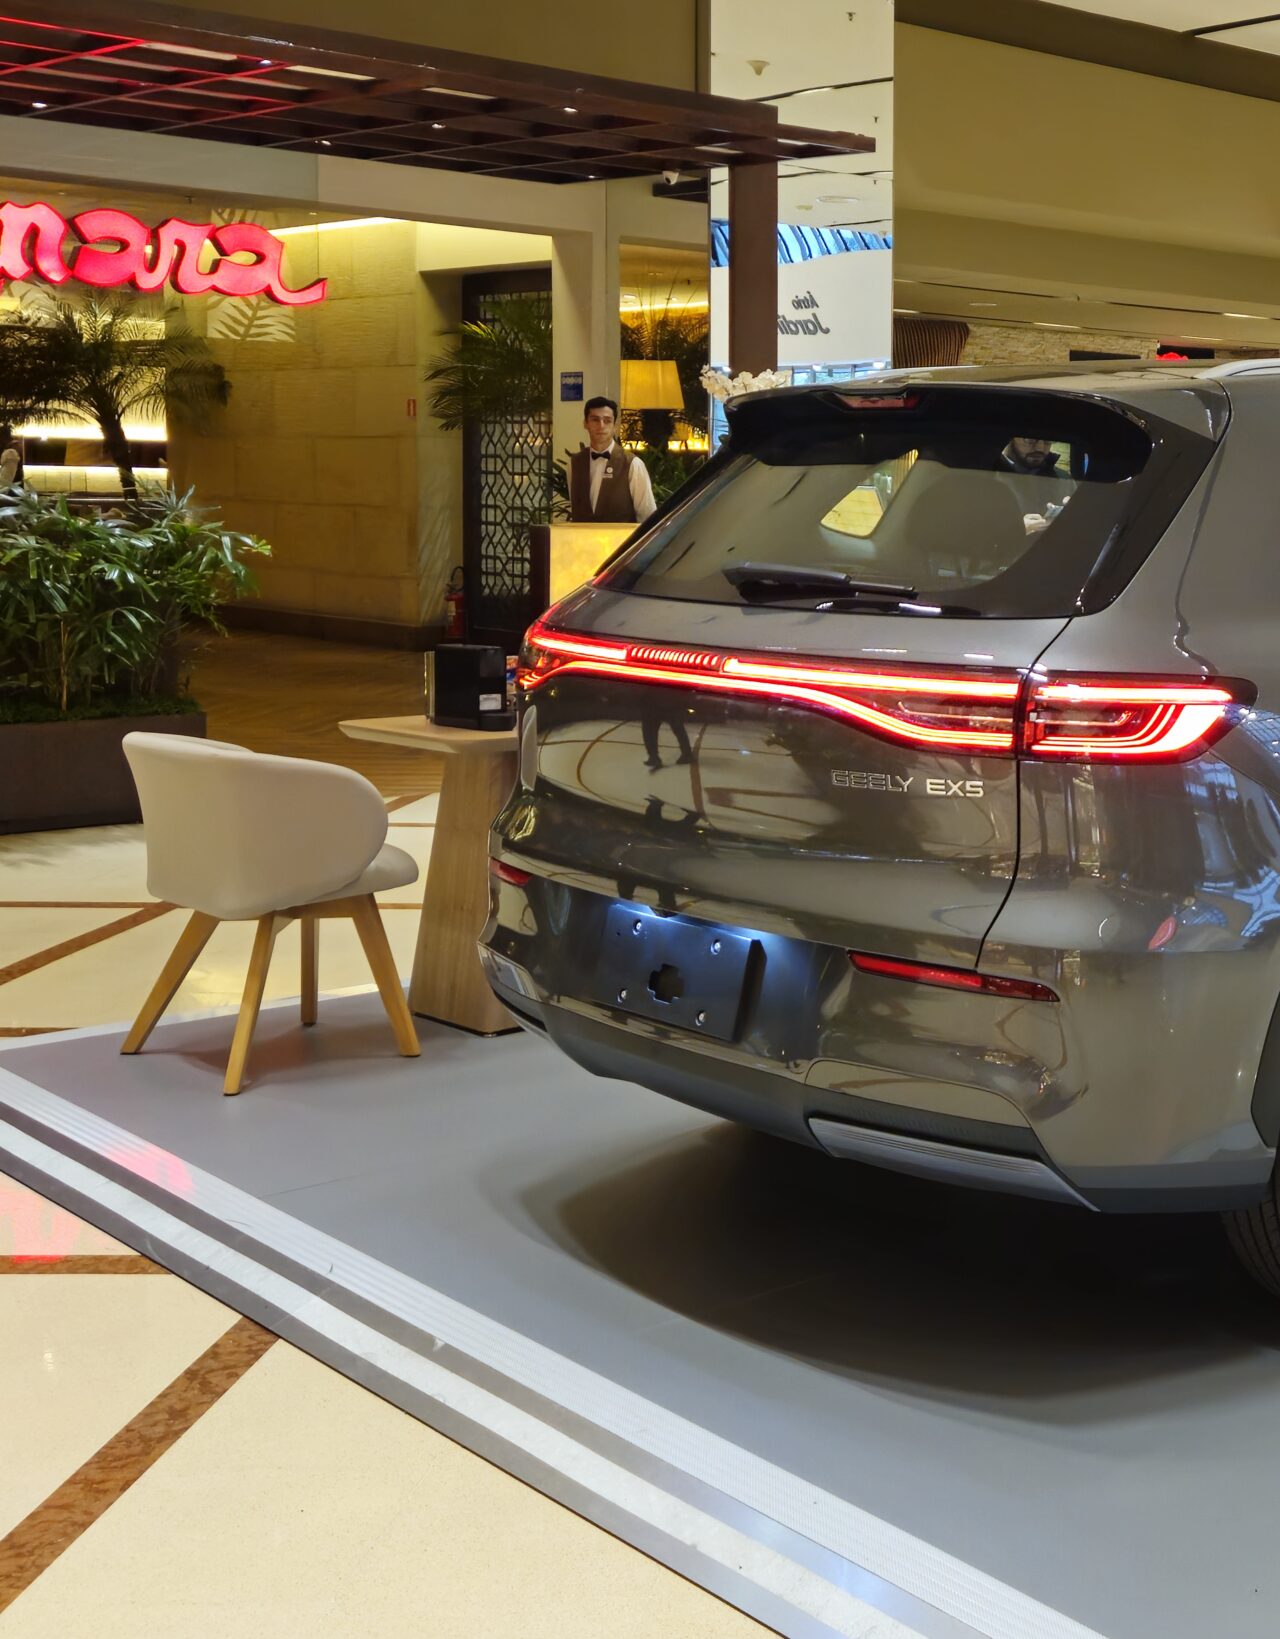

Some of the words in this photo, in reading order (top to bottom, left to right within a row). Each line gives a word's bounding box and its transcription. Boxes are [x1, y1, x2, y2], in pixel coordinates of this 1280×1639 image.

[0, 200, 327, 306] nara
[831, 769, 914, 793] GEELY
[926, 778, 984, 798] EX5
